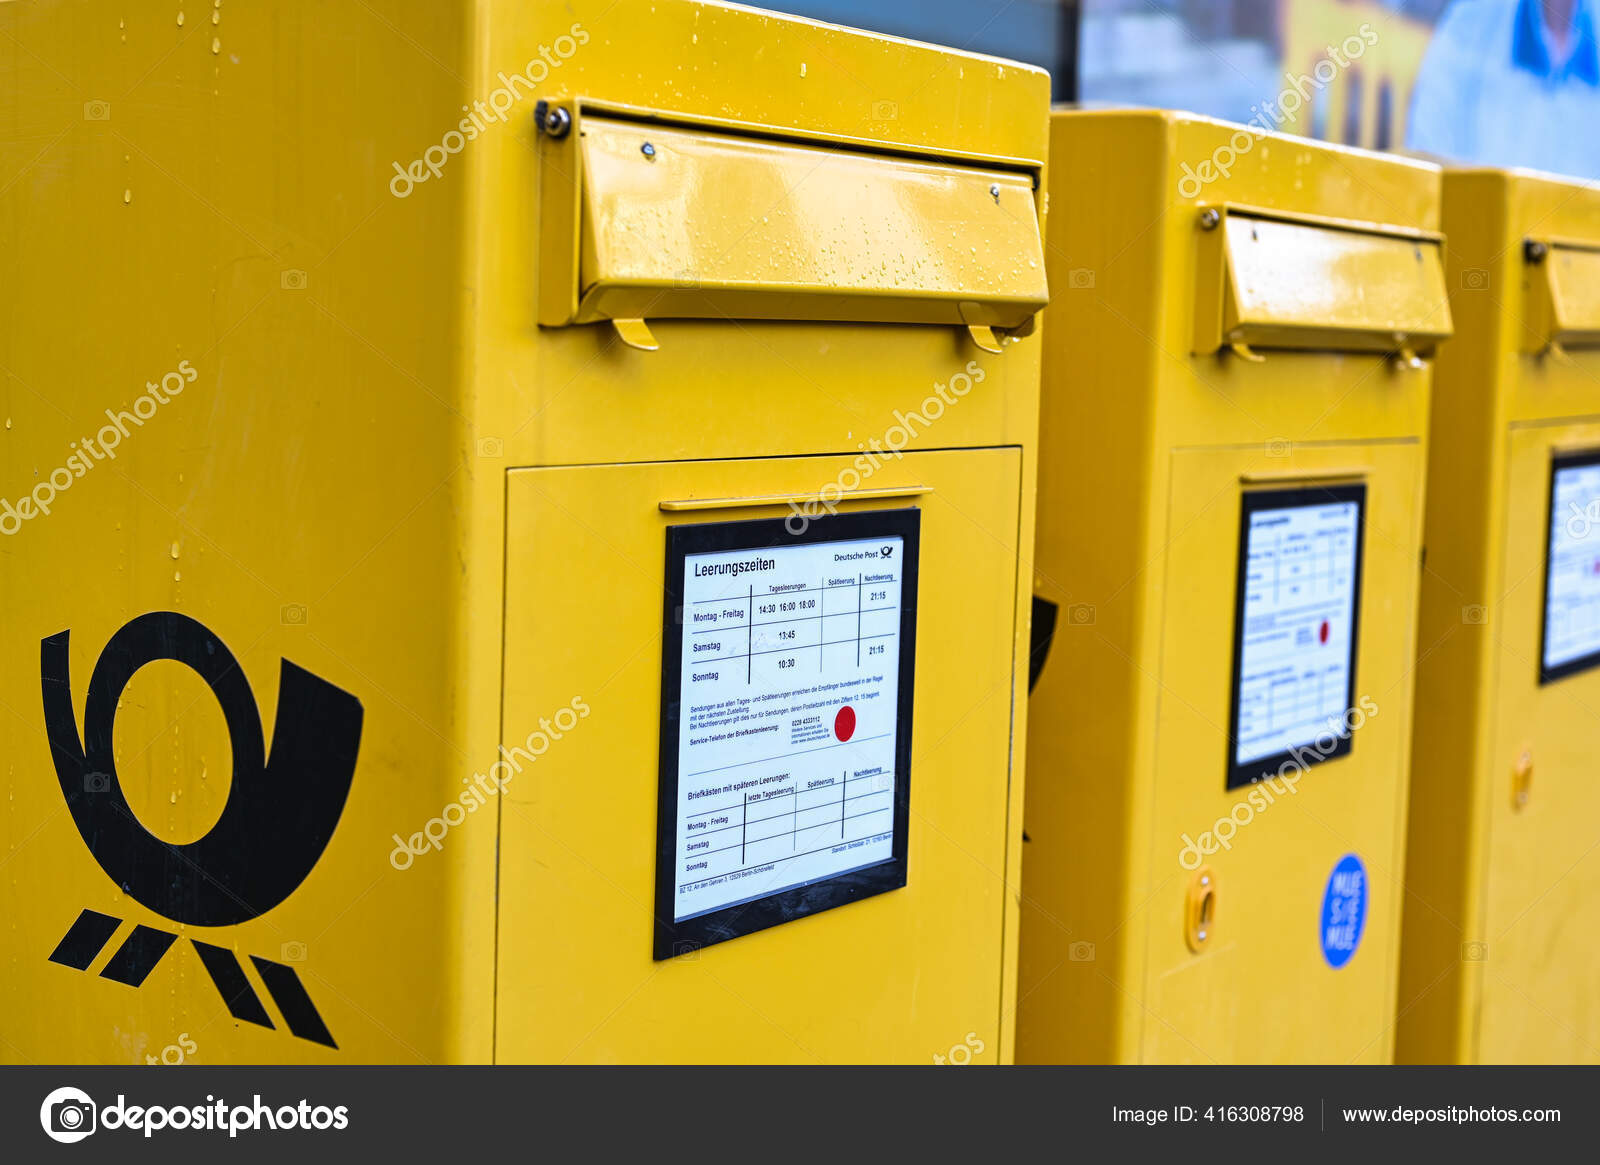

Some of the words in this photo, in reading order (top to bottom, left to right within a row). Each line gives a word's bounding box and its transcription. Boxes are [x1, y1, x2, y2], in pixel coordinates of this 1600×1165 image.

[834, 552, 864, 561] Deutsche
[864, 551, 878, 559] Post
[694, 557, 775, 577] Leerungszeiten
[769, 583, 806, 594] Tagesleerungen
[870, 591, 886, 600] 21:15
[759, 604, 776, 614] 14:30
[779, 602, 796, 612] 16:00
[799, 599, 816, 609] 18:00
[693, 612, 717, 622] Montag
[722, 609, 744, 619] Freitag
[778, 630, 796, 640] 13:45
[693, 641, 721, 653] Samstag
[869, 645, 884, 655] 21:15
[778, 658, 795, 669] 10:30
[692, 671, 719, 682] Sonntag
[854, 766, 882, 777] Nachtleerung
[687, 787, 721, 800] Briefkästen
[722, 785, 732, 793] mit
[733, 780, 759, 790] späteren
[759, 772, 791, 785] Leerungen:
[807, 777, 835, 788] Spätleerung
[747, 793, 761, 801] letzte
[762, 786, 794, 799] Tagesleerung
[687, 821, 707, 831] Montag
[710, 816, 729, 825] Freitag
[686, 840, 710, 851] Samstag
[686, 861, 708, 871] Sonntag
